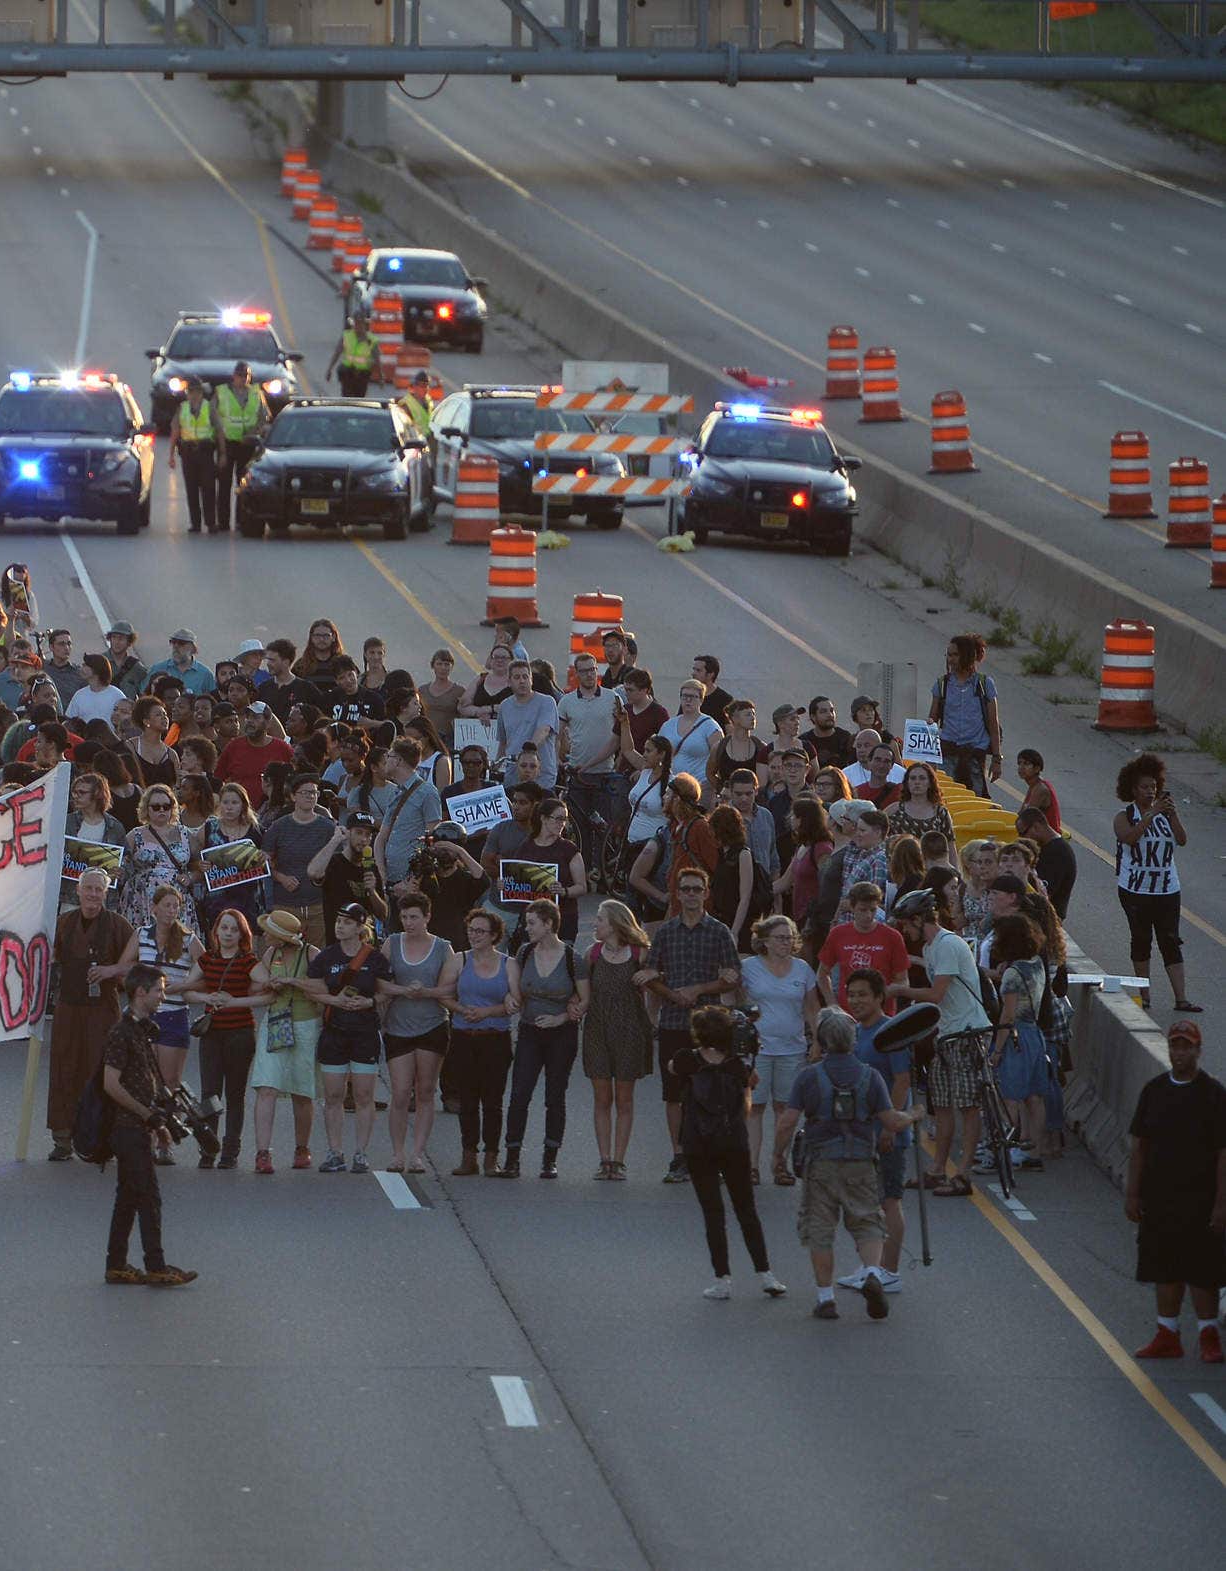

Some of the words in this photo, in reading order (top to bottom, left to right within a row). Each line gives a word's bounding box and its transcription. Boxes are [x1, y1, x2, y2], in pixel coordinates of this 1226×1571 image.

[455, 799, 504, 824] SHAME
[1130, 841, 1173, 867] AKA
[209, 866, 238, 880] STAND
[504, 882, 532, 892] STAND
